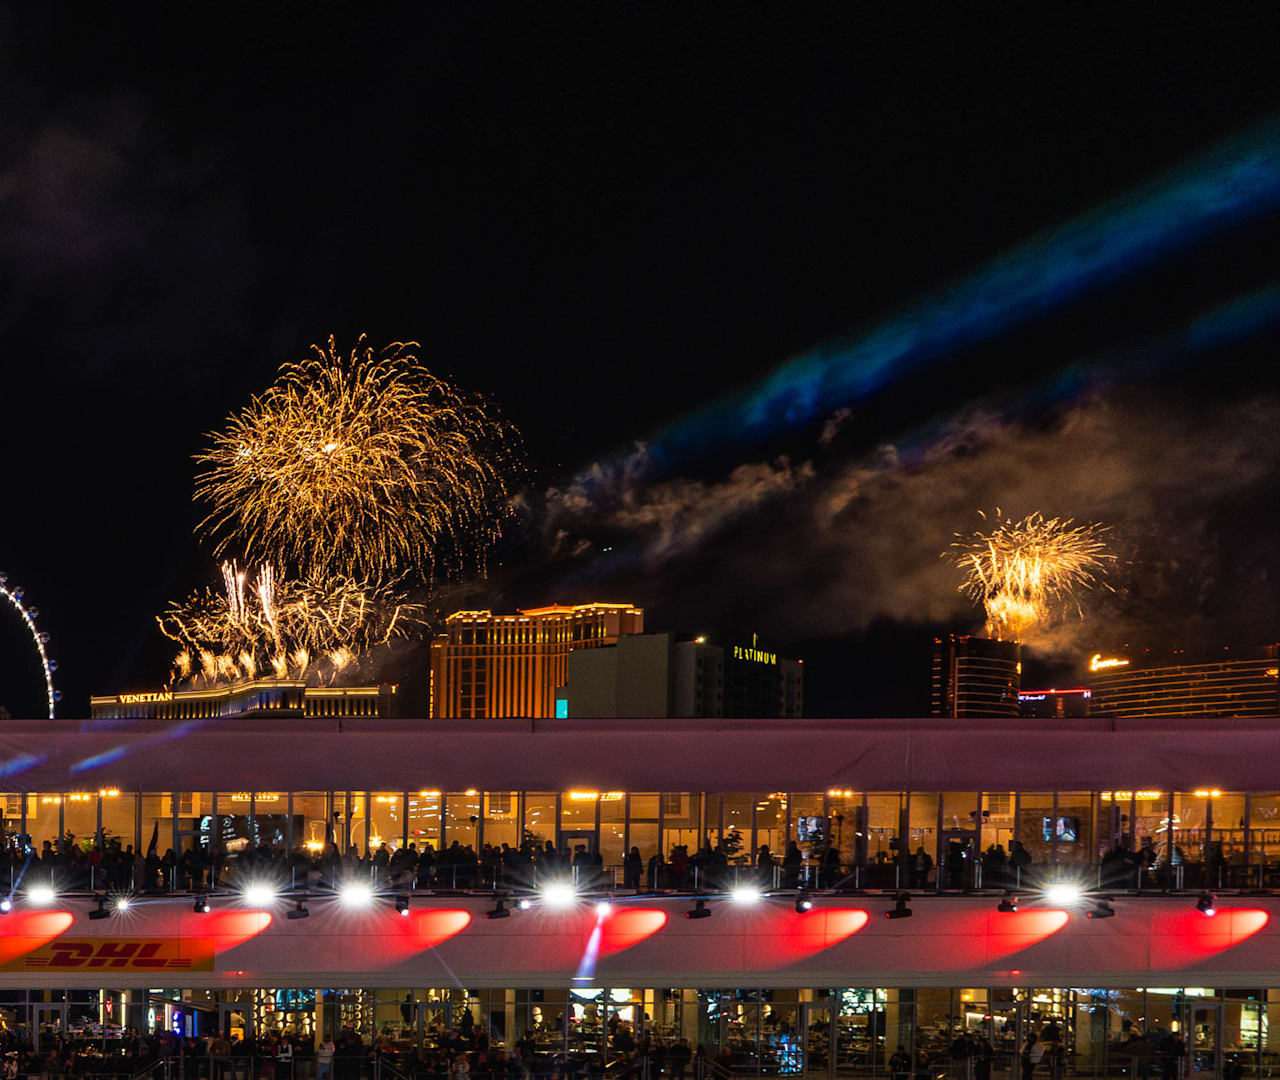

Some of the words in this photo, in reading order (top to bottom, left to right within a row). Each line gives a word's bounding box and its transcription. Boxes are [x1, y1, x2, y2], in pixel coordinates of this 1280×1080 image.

[734, 646, 776, 665] PLATINUM
[120, 693, 173, 703] VENETIAN
[50, 943, 169, 967] DHL
